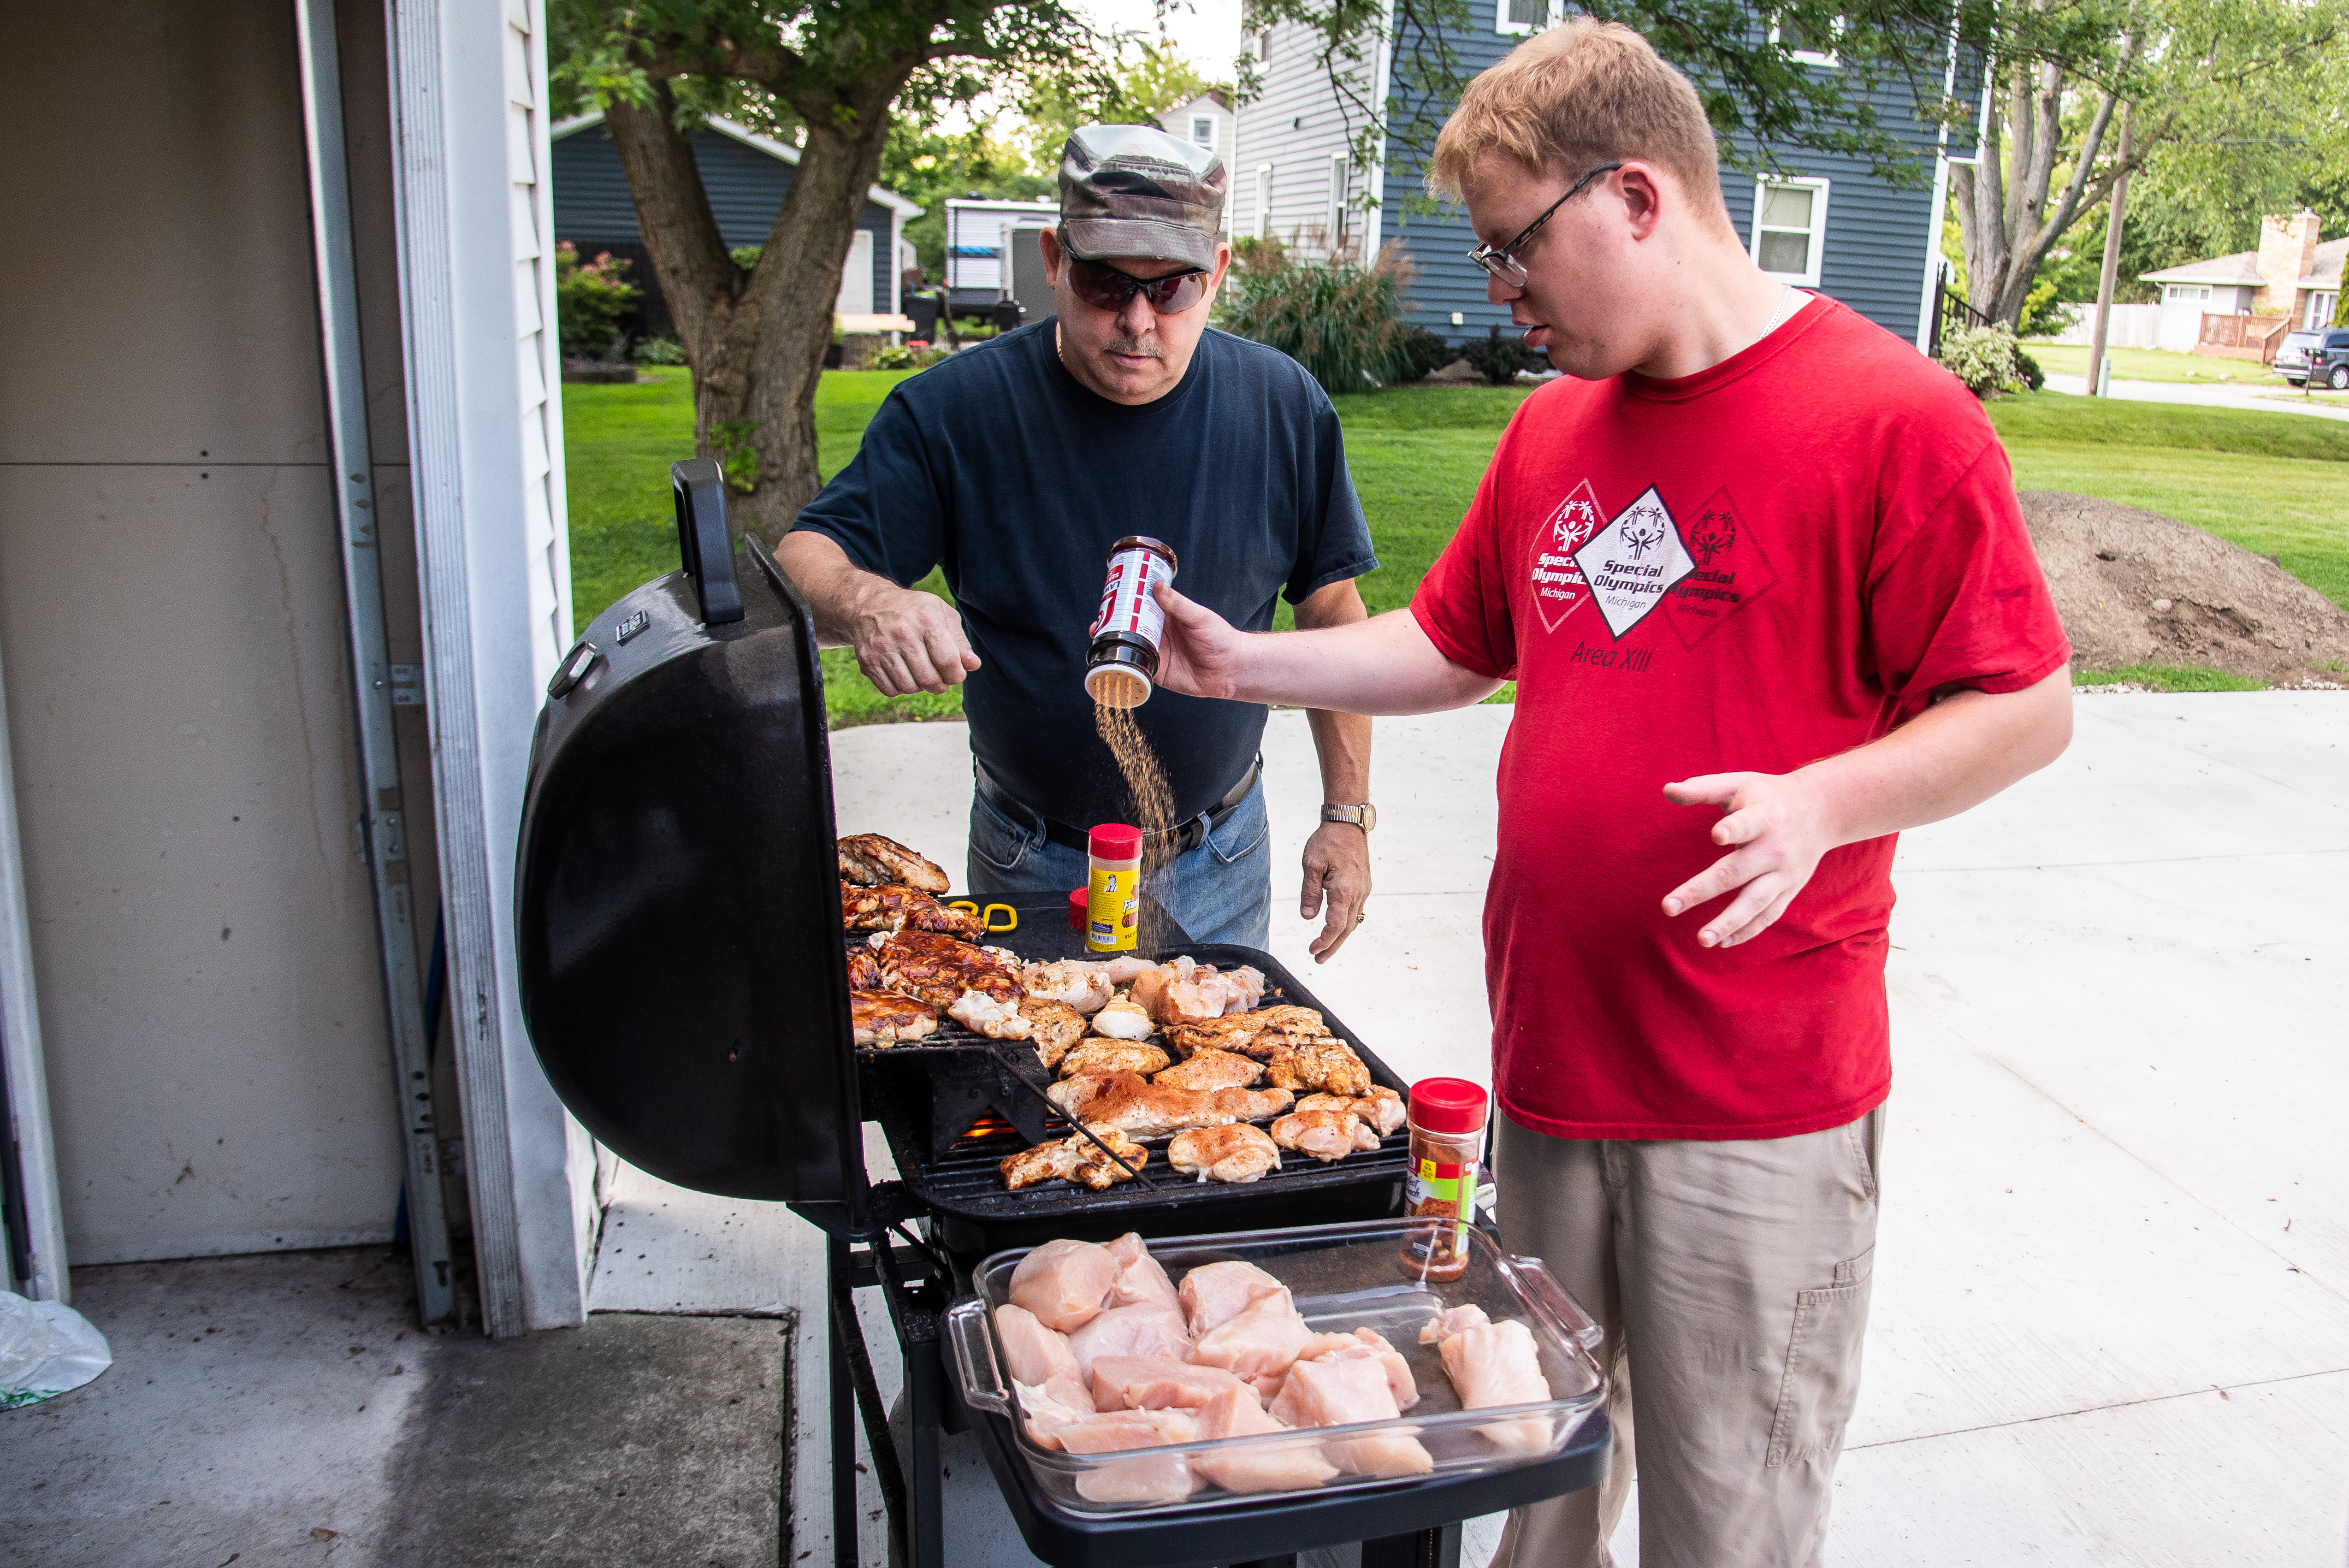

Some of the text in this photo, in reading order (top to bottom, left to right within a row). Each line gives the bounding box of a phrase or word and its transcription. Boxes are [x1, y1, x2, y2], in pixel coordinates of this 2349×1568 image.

[1538, 553, 1577, 568] Spec
[1603, 560, 1663, 577] Special
[1532, 568, 1587, 586] Olympic
[1594, 575, 1664, 594] Olympics
[1692, 569, 1736, 584] ecial
[1540, 587, 1576, 601] Michigan
[1671, 586, 1740, 603] ympics
[1605, 595, 1646, 610] Michigan
[1676, 603, 1717, 619] Michigan
[1570, 640, 1654, 673] Area XIII
